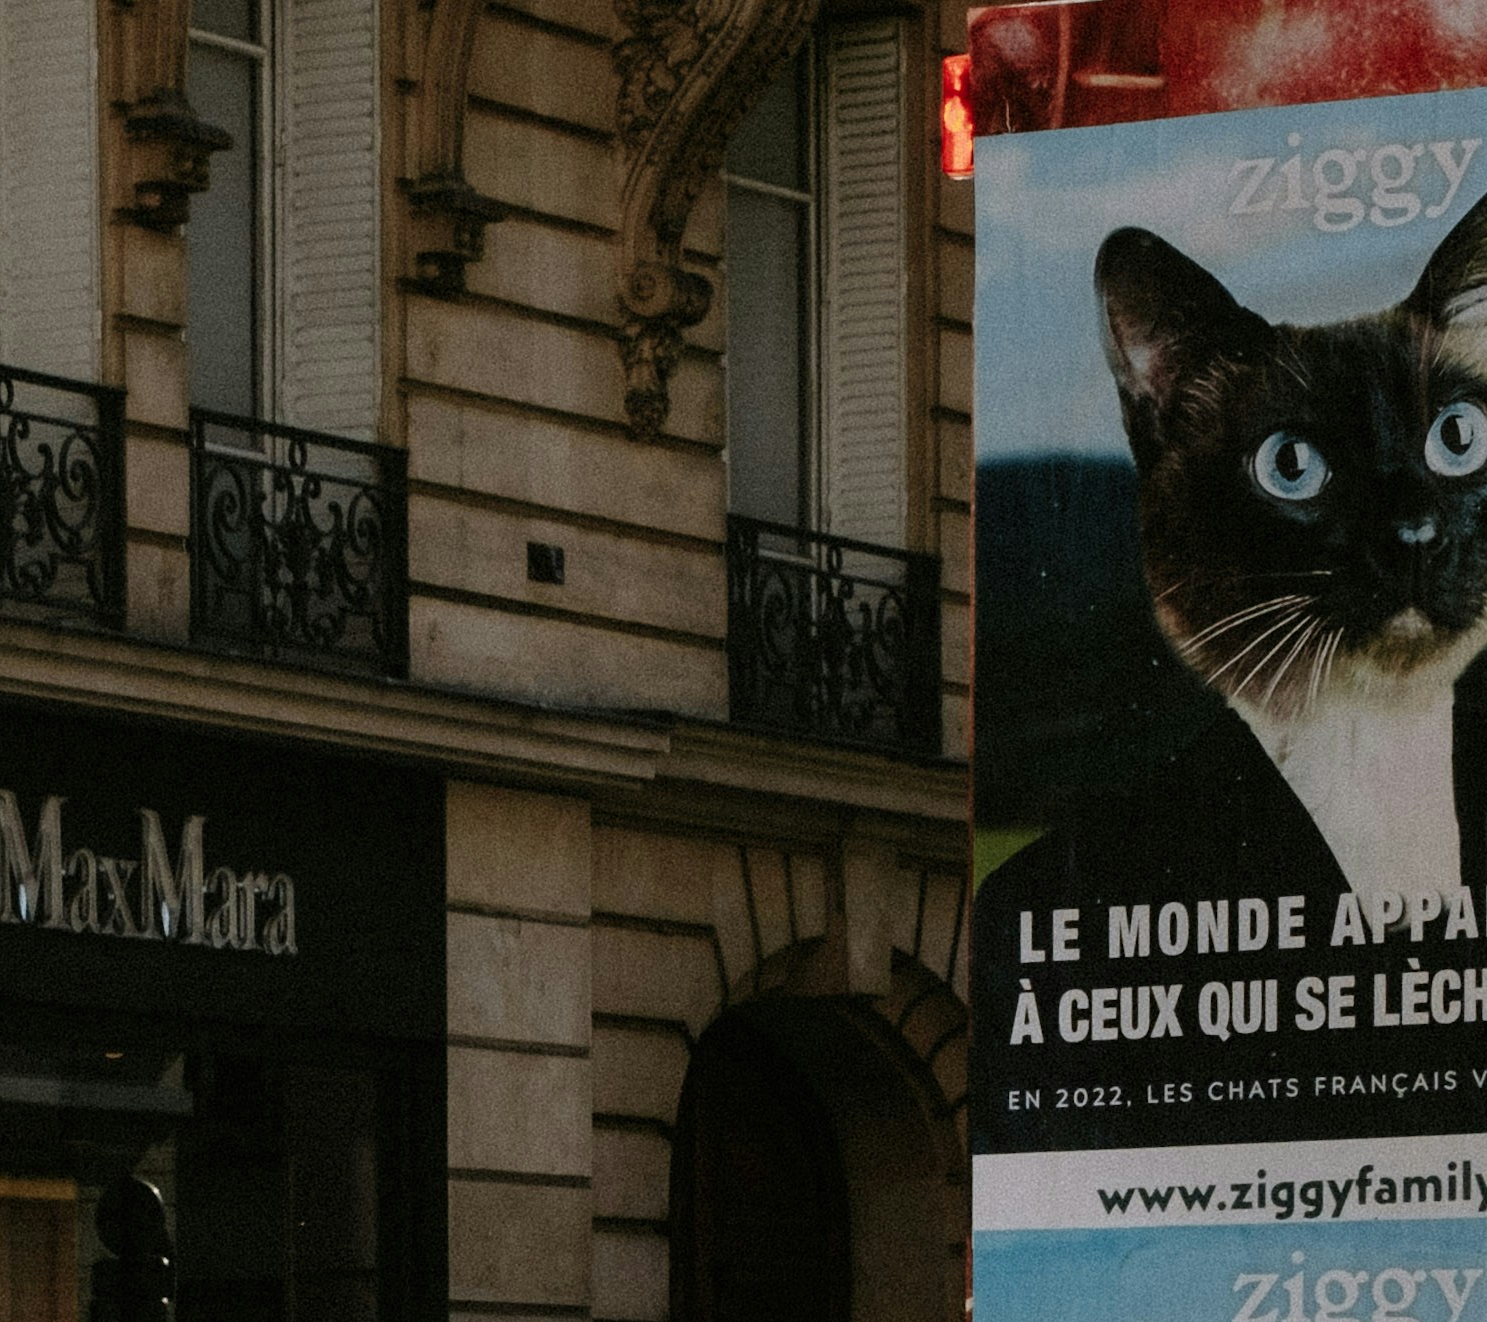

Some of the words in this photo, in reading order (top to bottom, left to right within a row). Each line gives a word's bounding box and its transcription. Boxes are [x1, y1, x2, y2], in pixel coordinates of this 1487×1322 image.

[1226, 131, 1483, 233] ziggy
[1019, 907, 1081, 964] LE
[1107, 894, 1307, 959] MONDE
[1009, 978, 1044, 1045] À
[1058, 983, 1185, 1044] CEUX
[1198, 978, 1279, 1042] QUI
[1295, 974, 1357, 1032] SE
[1008, 1090, 1042, 1111] EN
[1056, 1085, 1133, 1109] 2022,
[1147, 1082, 1193, 1105] LES
[1207, 1077, 1300, 1101] CHATS
[1315, 1070, 1458, 1099] FRANÇAIS
